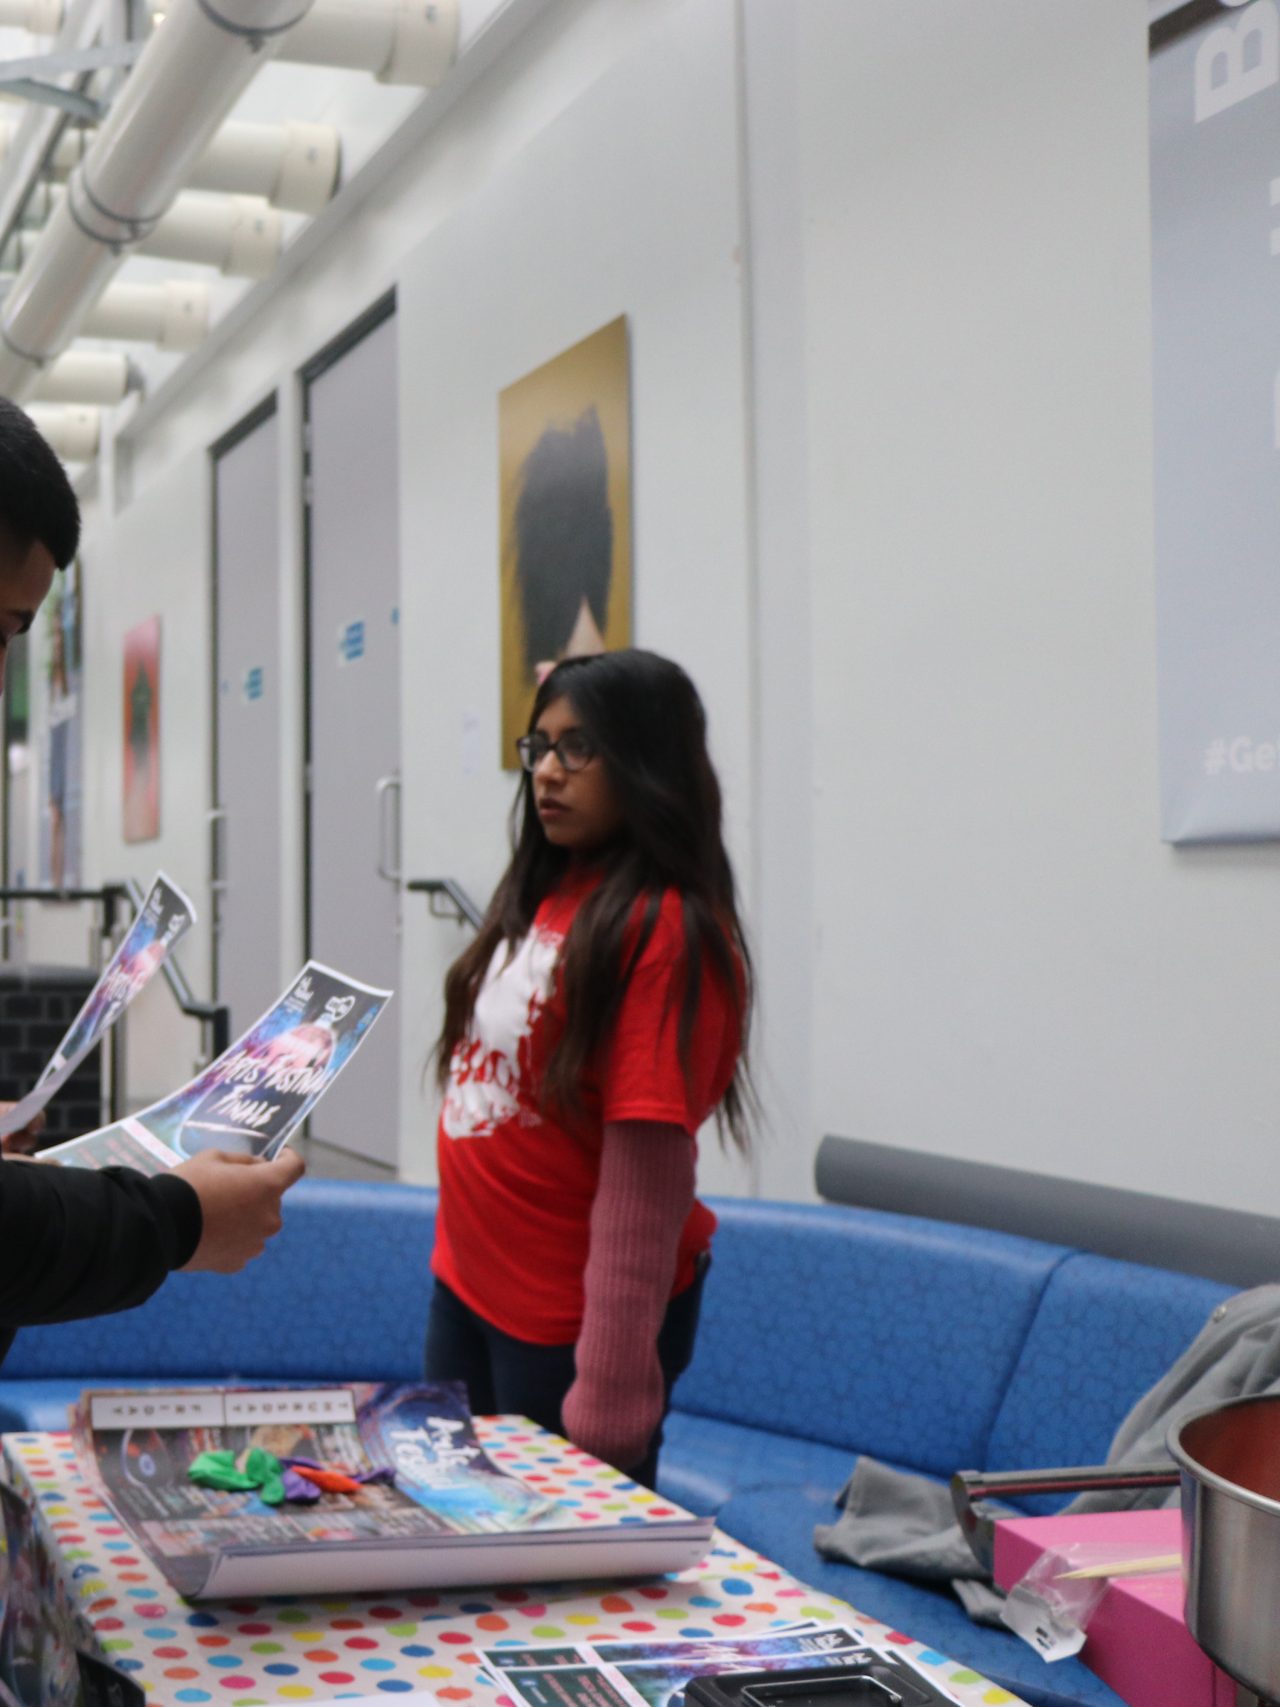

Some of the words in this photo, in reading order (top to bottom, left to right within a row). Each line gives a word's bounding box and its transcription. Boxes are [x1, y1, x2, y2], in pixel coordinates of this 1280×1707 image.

[1204, 735, 1280, 775] #Ge
[113, 1404, 202, 1416] FRIDAY
[232, 1401, 349, 1413] THURSDAY
